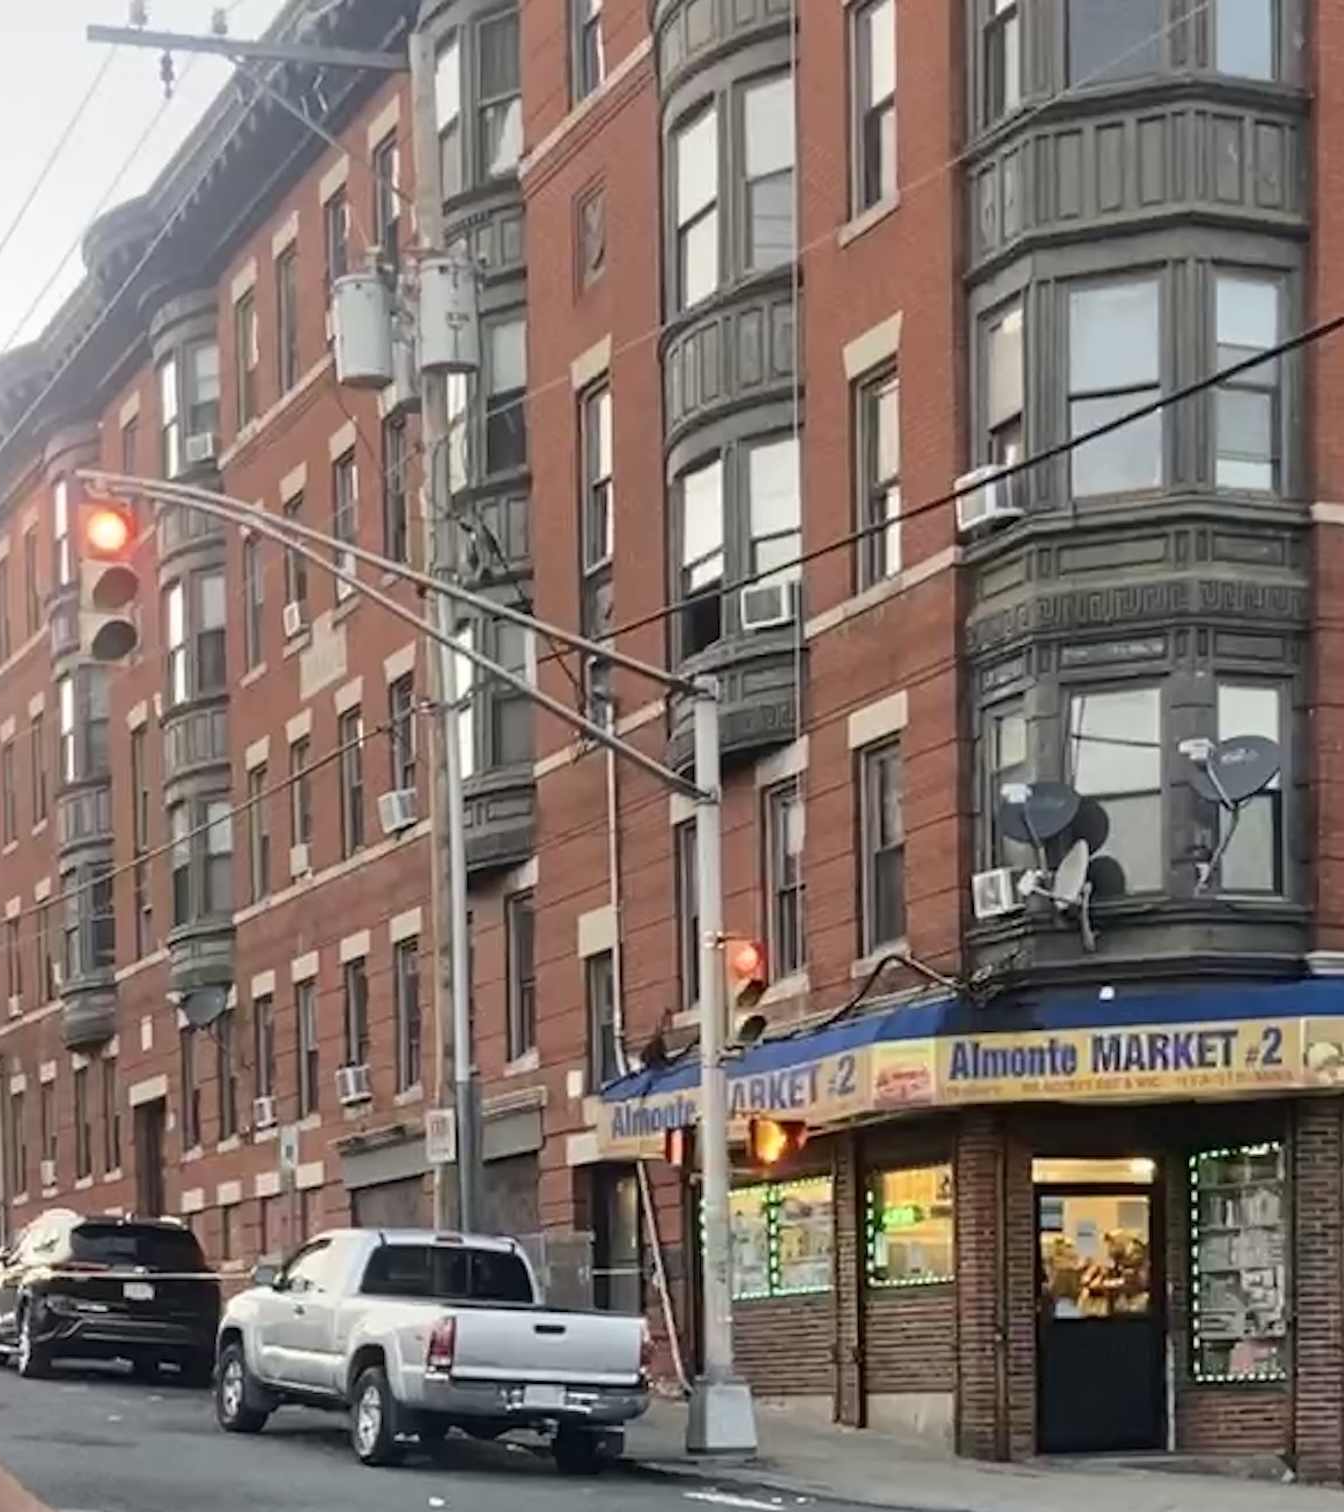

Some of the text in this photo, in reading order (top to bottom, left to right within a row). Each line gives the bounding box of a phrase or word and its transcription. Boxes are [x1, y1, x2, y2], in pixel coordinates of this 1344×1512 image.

[949, 1040, 1078, 1081] Almonte
[1091, 1029, 1240, 1073] MARKET
[612, 1096, 697, 1139] Almonte
[730, 1064, 821, 1115] ARKET
